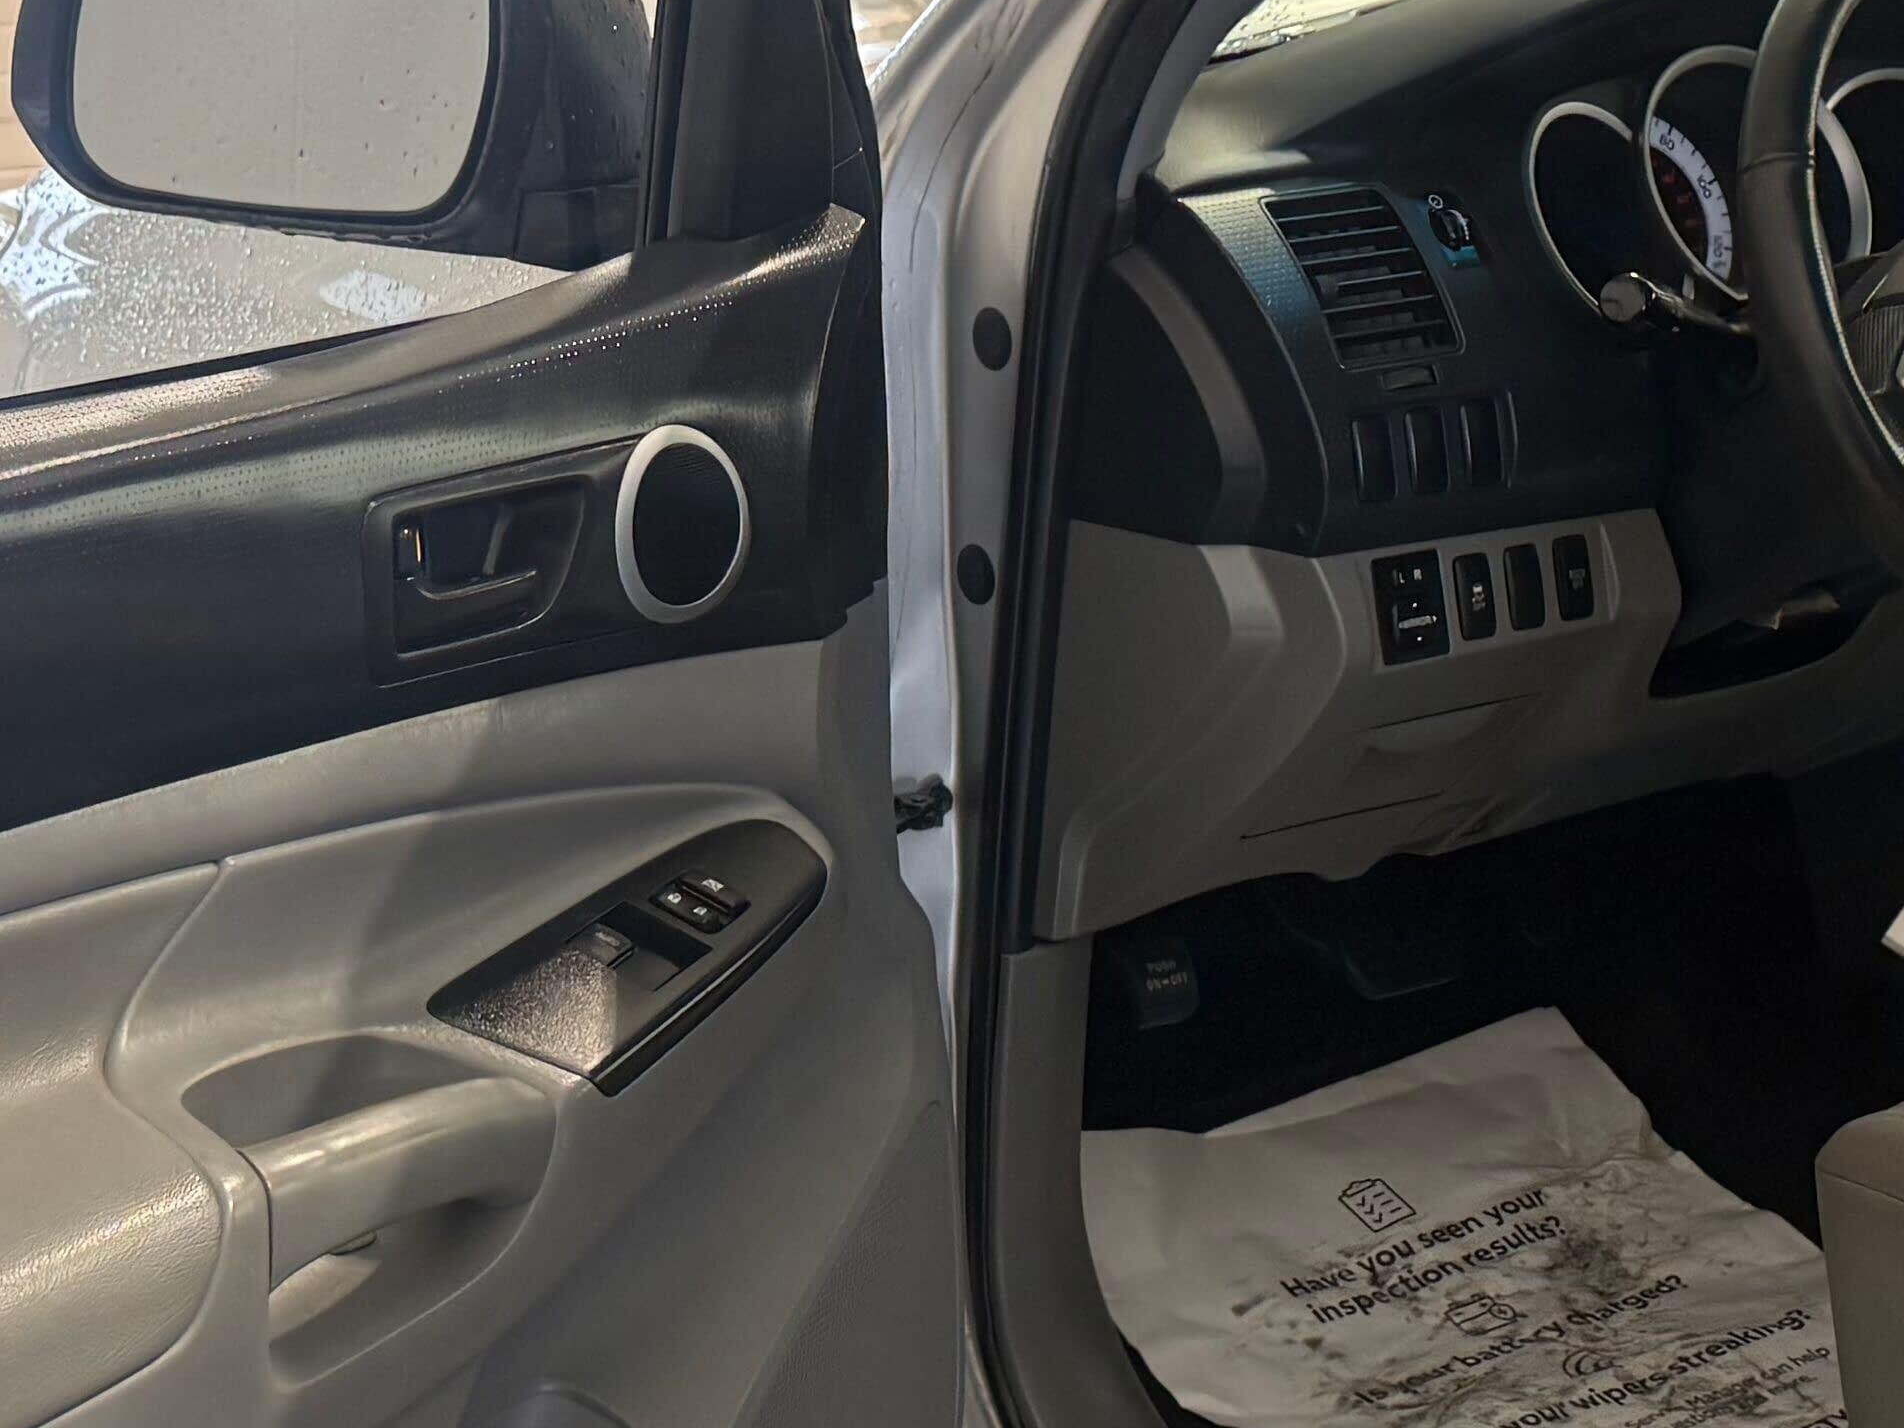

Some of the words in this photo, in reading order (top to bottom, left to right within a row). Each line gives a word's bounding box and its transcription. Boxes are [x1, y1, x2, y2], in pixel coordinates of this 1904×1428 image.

[1280, 1266, 1358, 1298] Have
[1356, 1238, 1417, 1280] you
[1416, 1213, 1485, 1249] seen
[1482, 1187, 1548, 1227] your
[1306, 1259, 1465, 1324] inspection
[1462, 1215, 1567, 1268] results?
[1354, 1387, 1389, 1405] Is
[1569, 1367, 1671, 1412] wipers
[1667, 1307, 1813, 1376] streaking?
[1790, 1345, 1832, 1373] help
